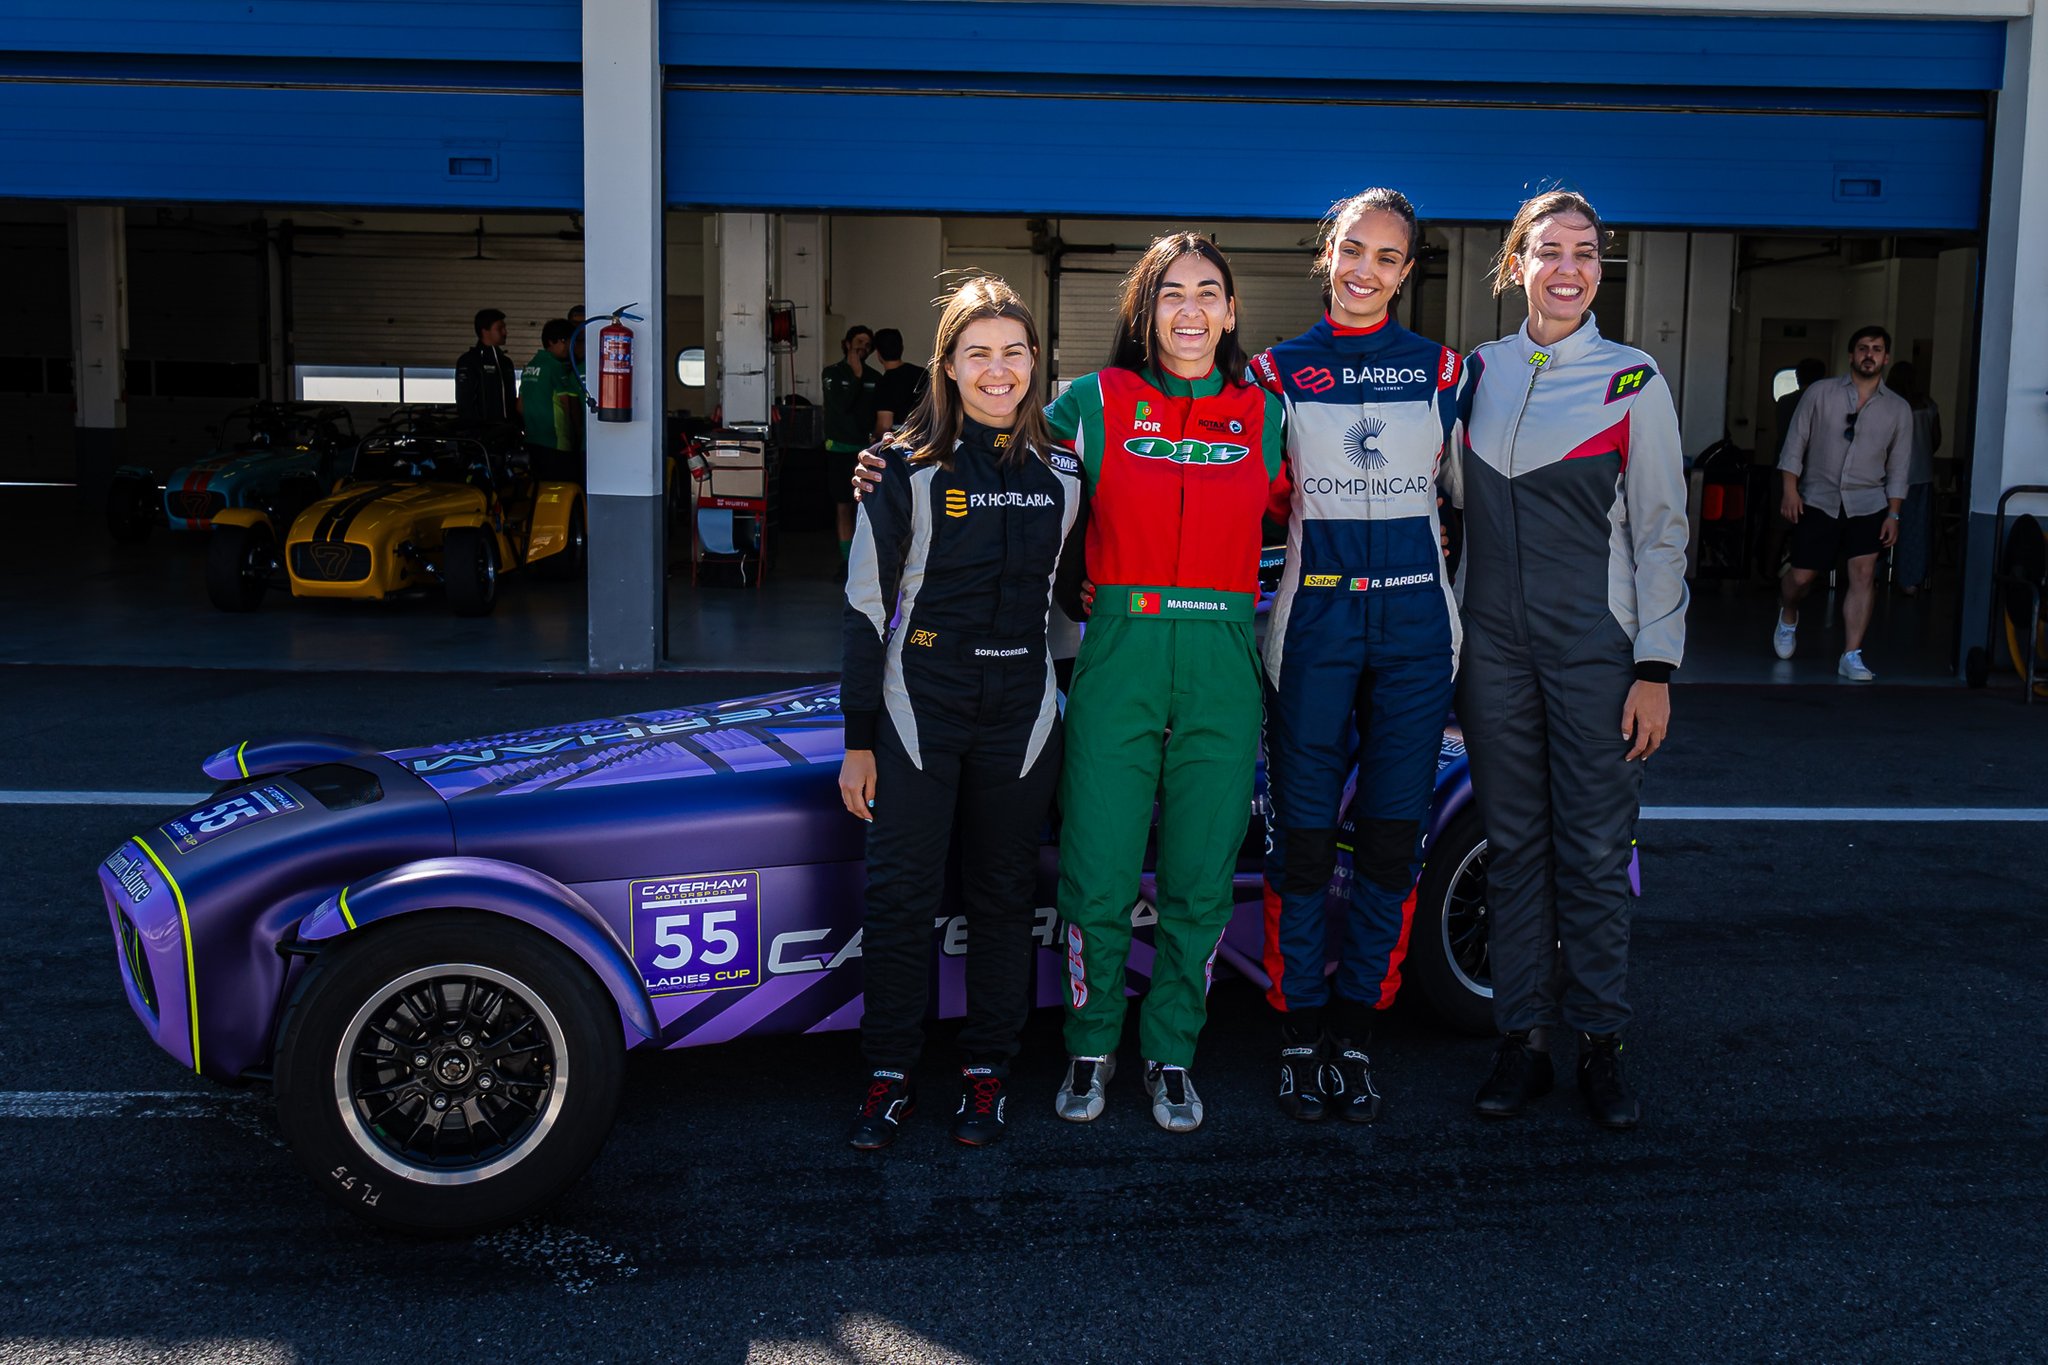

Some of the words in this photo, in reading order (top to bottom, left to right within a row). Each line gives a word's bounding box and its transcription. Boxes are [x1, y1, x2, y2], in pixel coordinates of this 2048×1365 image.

[1343, 367, 1427, 384] BARBOS
[1134, 420, 1161, 432] POR
[1051, 457, 1078, 470] OMP
[1303, 476, 1428, 495] COMPINCAR
[970, 494, 986, 507] FX
[989, 492, 1055, 506] HOTELARIA
[1371, 578, 1383, 588] R.
[1385, 573, 1434, 587] BARBOSA
[1167, 600, 1218, 611] MARGARIDA
[1220, 600, 1228, 611] B.
[911, 629, 937, 647] FX
[975, 649, 999, 657] SOFIA
[1000, 647, 1029, 657] CORREIA
[189, 797, 259, 833] 55
[170, 821, 190, 837] LADIES
[183, 832, 199, 847] CUP
[641, 878, 747, 896] CATERHAM
[655, 888, 735, 901] MOTORSPORT
[652, 909, 740, 970] 55
[646, 973, 711, 988] LADIES
[714, 969, 751, 981] CUP
